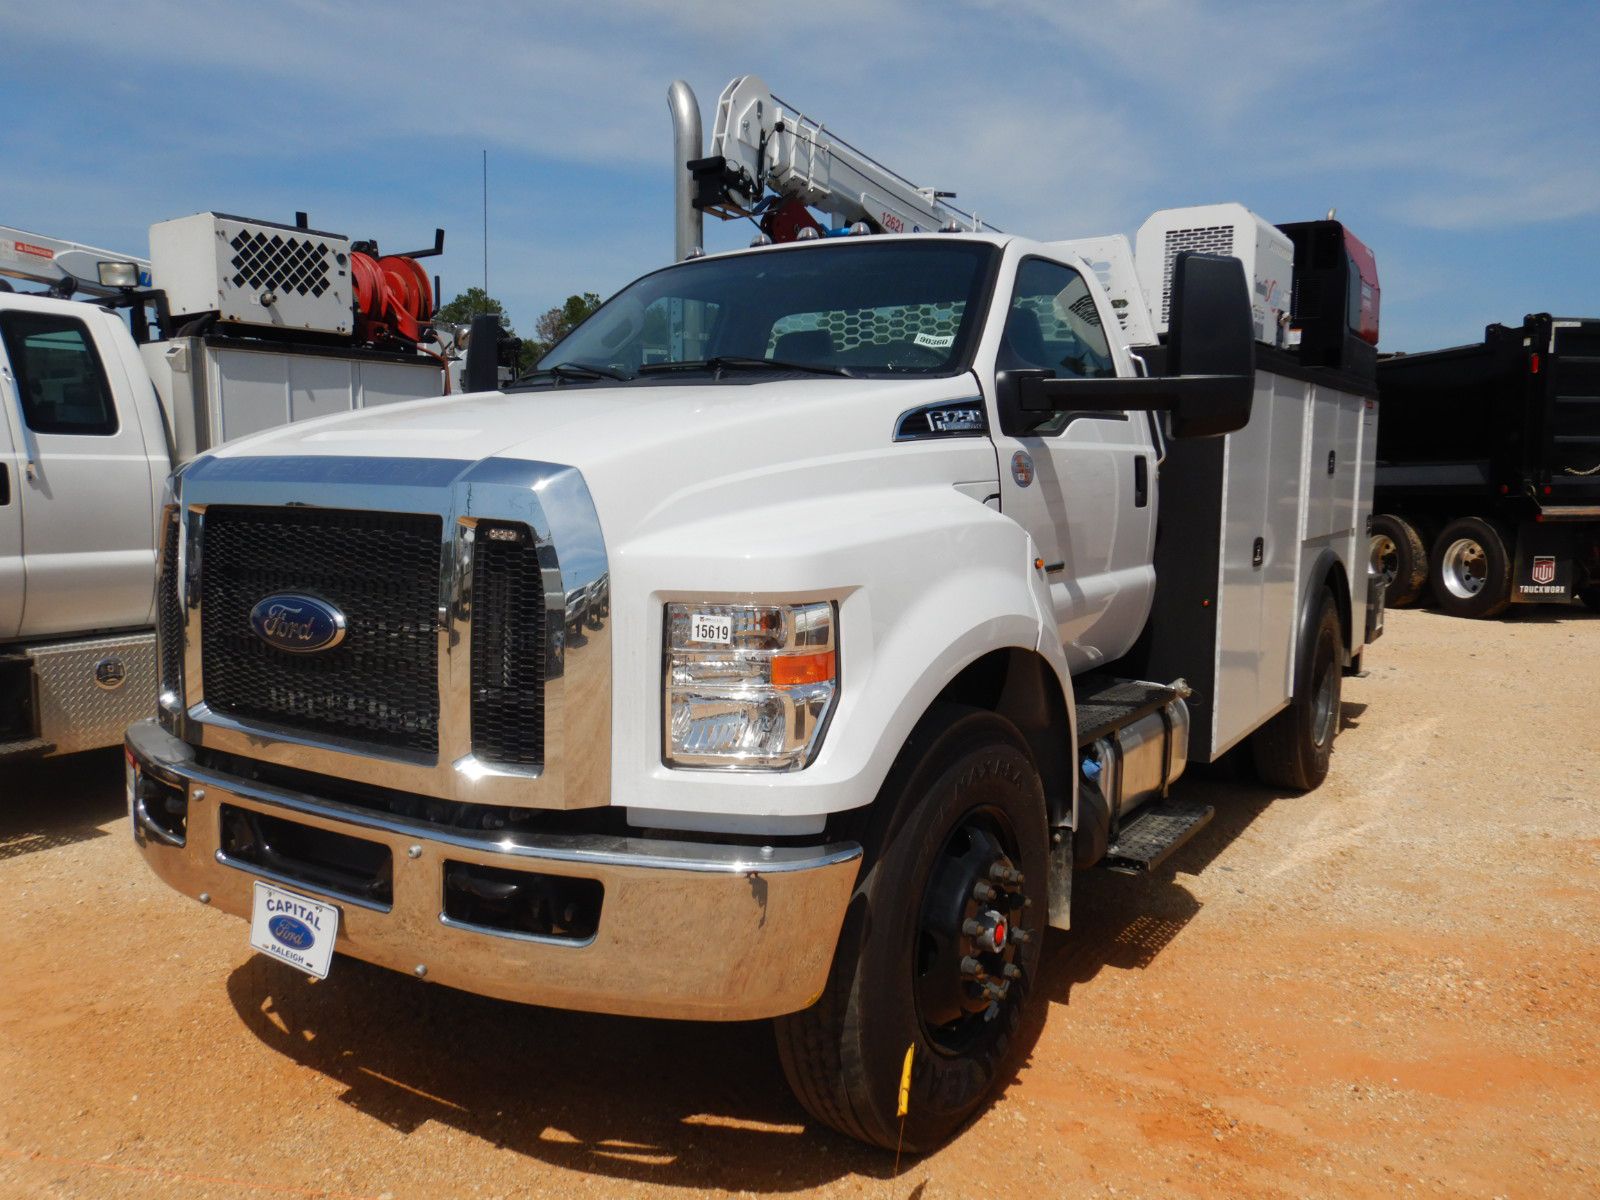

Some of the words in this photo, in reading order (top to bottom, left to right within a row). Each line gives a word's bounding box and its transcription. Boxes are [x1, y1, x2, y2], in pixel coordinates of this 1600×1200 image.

[264, 604, 314, 641] Ford
[694, 623, 729, 640] 15619
[266, 899, 322, 932] CAPITAL
[275, 920, 305, 945] Ford
[270, 944, 304, 964] RALEIGH
